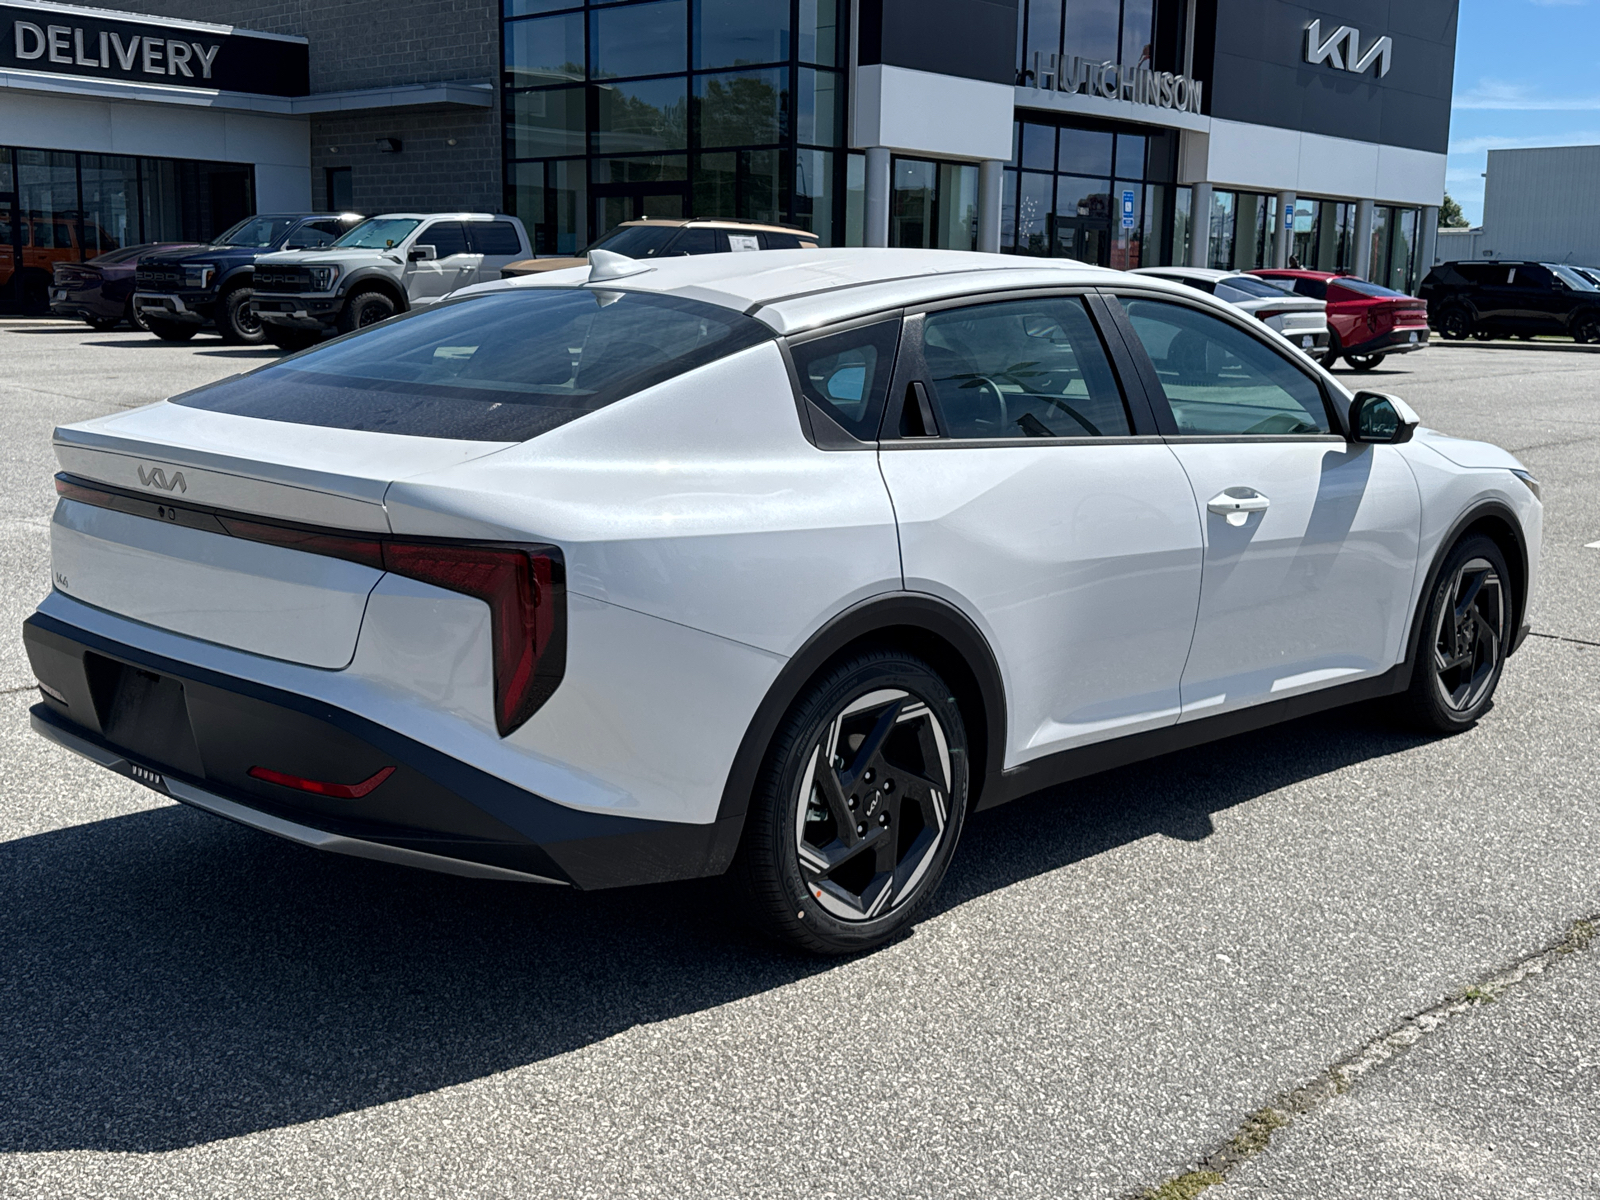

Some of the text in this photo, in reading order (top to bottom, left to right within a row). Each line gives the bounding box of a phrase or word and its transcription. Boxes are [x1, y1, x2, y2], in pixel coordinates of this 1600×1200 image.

[14, 20, 220, 79] DELIVERY
[1305, 18, 1392, 78] KIA
[1034, 51, 1203, 114] HUTCHINSON
[253, 273, 300, 283] FORD
[137, 464, 187, 493] KIA
